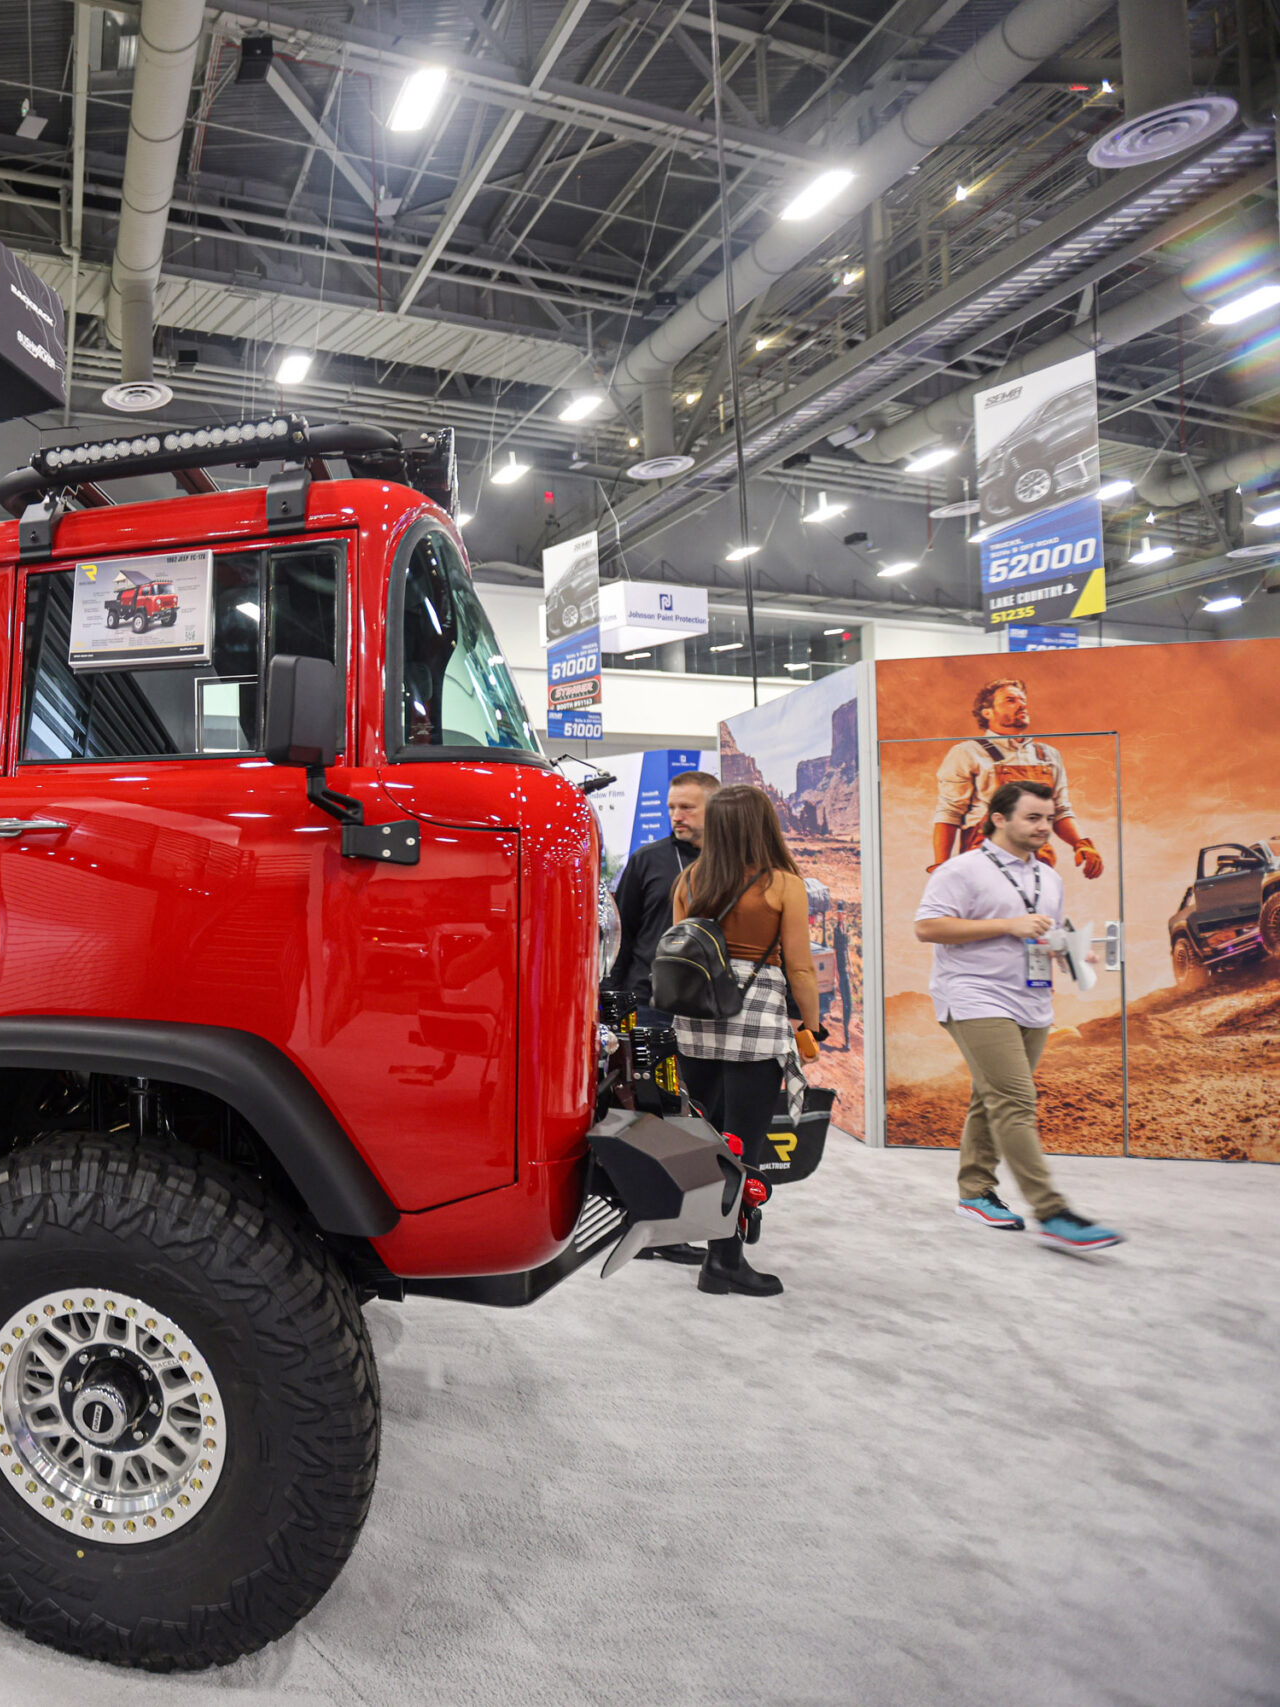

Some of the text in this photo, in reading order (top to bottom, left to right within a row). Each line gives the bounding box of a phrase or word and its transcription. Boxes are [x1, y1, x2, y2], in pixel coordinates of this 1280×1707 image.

[988, 537, 1097, 583] 52000
[628, 610, 706, 625] Johnson Paint Protection
[990, 605, 1036, 624] 51235
[551, 655, 597, 681] 51000
[564, 722, 601, 737] 51000
